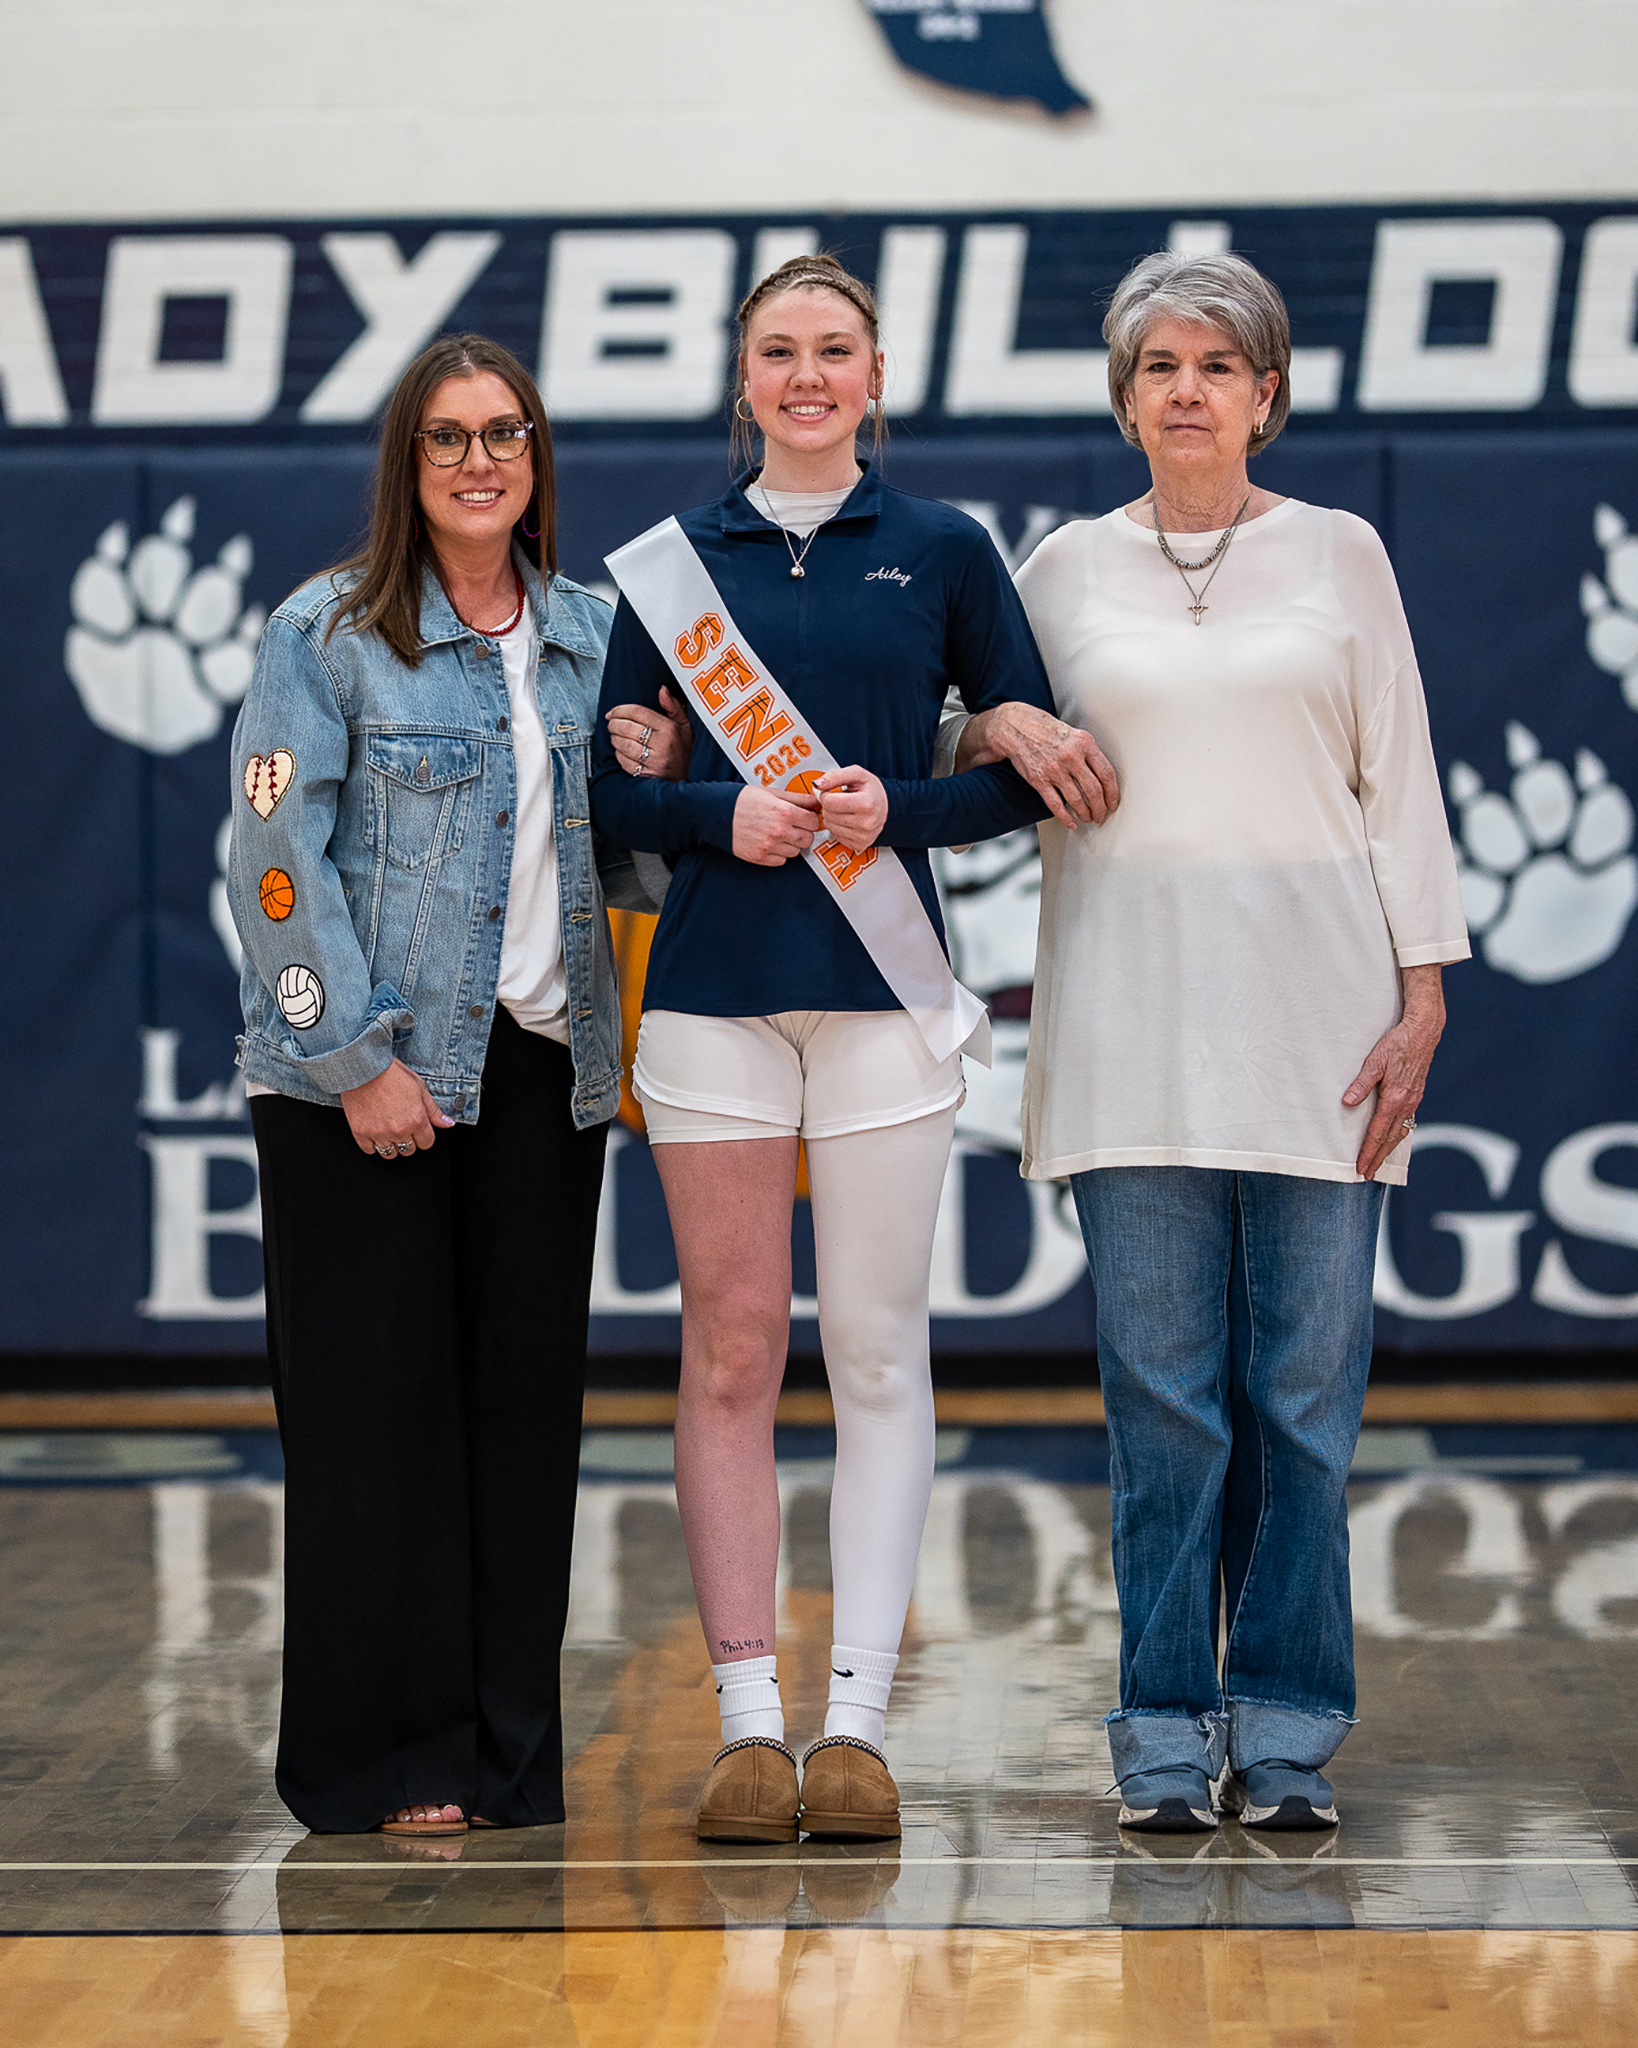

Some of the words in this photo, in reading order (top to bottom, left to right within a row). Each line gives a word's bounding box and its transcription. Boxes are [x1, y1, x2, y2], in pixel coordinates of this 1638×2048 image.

[864, 566, 912, 588] Ailey
[753, 734, 812, 787] 2026
[744, 1638, 765, 1649] 4:13
